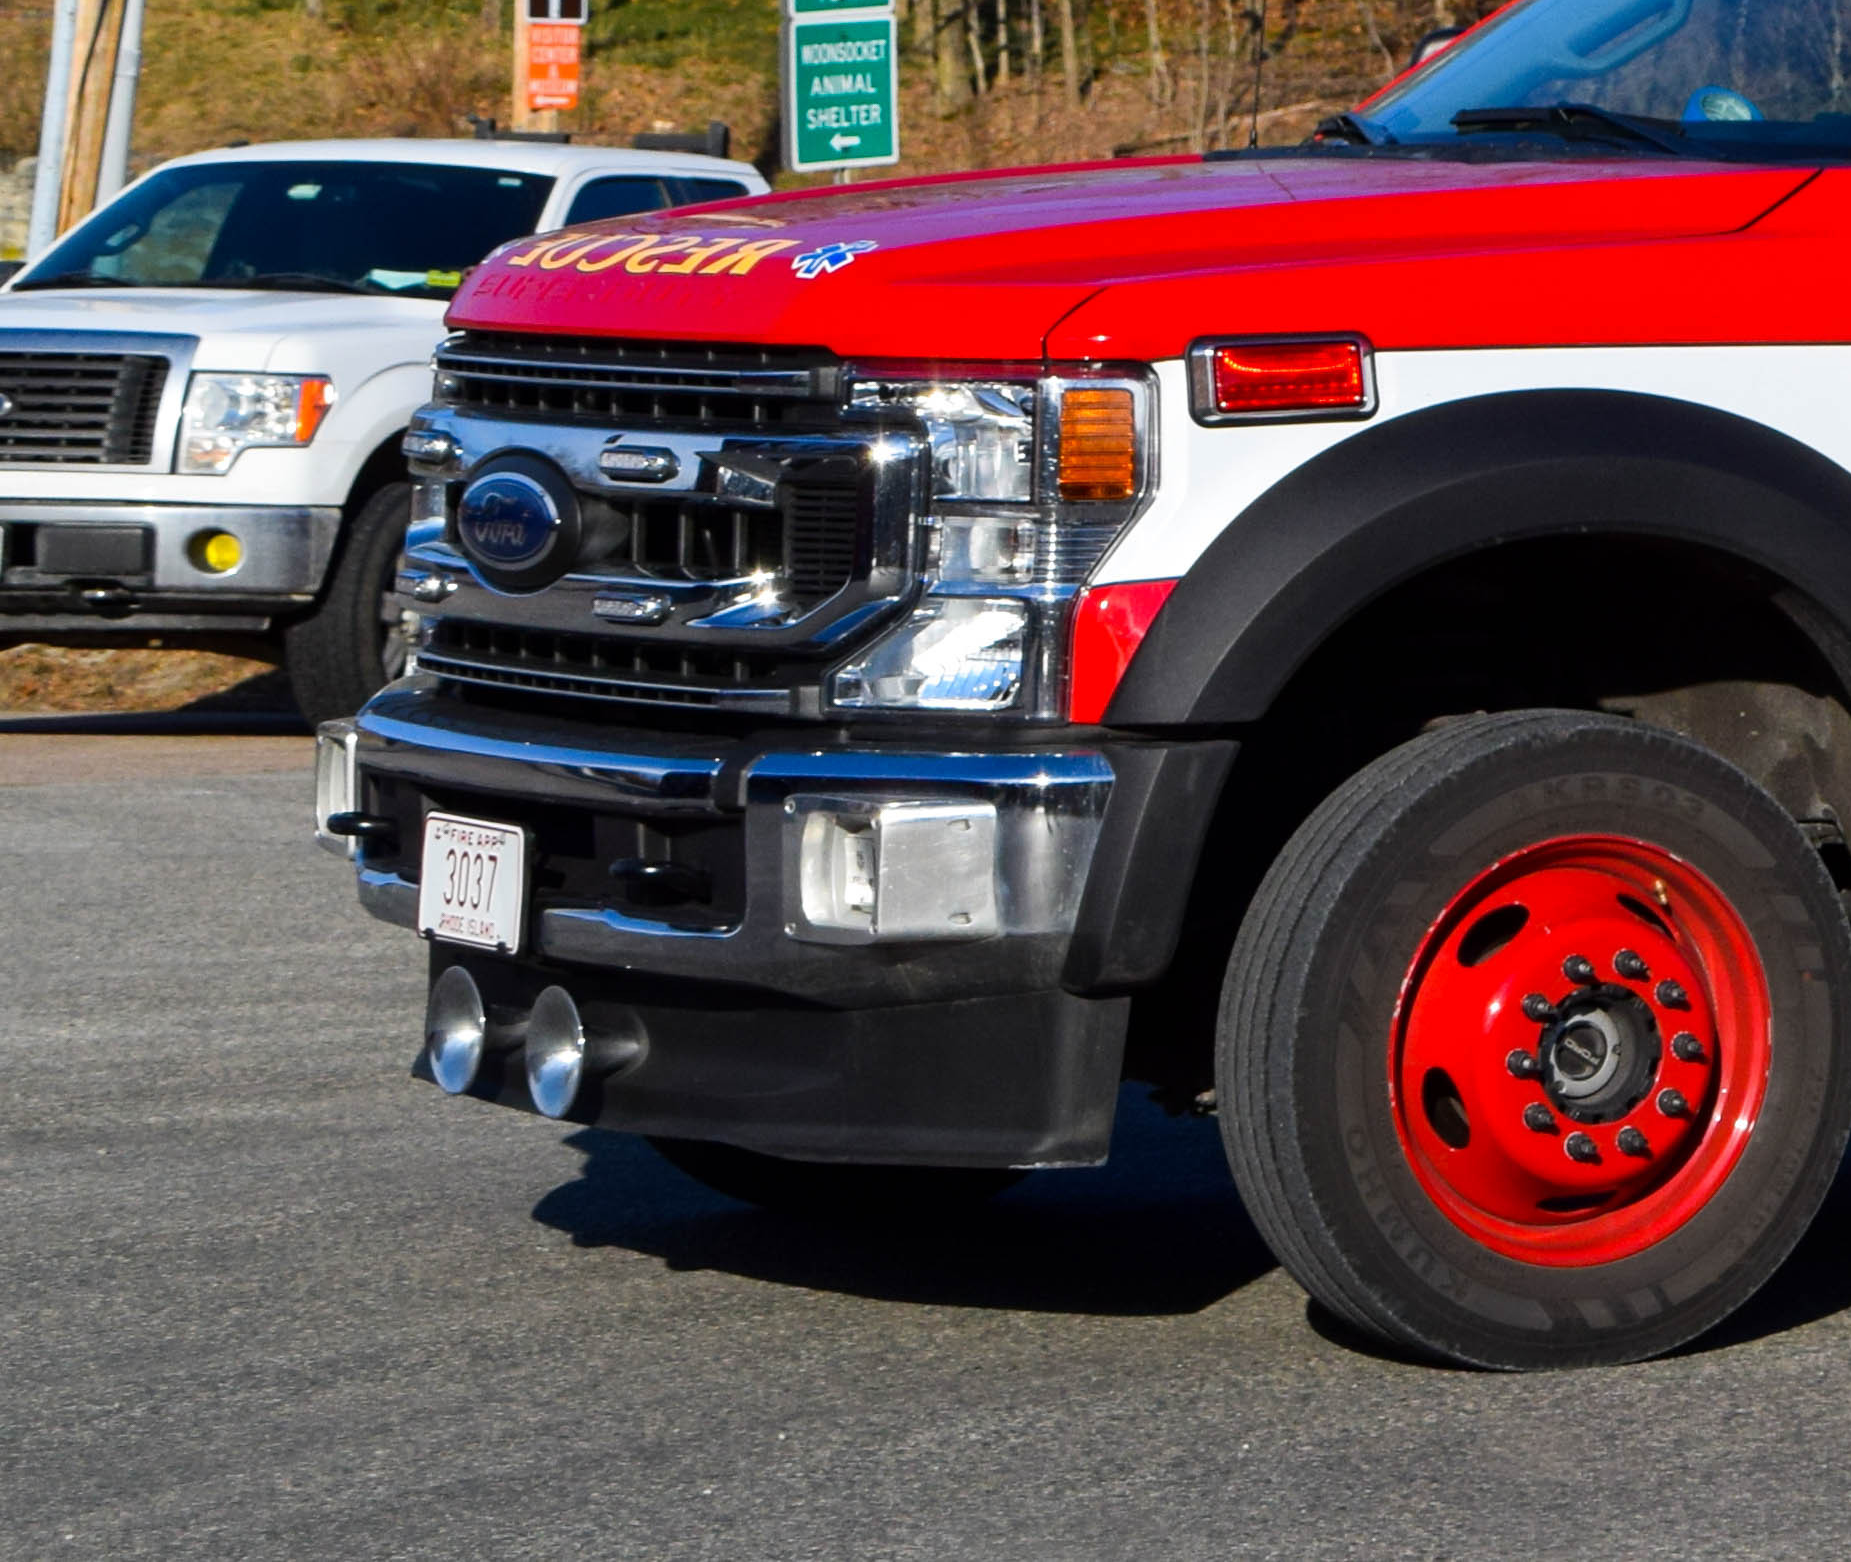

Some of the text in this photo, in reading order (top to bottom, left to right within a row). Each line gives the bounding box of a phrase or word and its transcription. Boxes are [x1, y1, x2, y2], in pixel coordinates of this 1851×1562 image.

[801, 39, 887, 65] WOONSOCKET
[810, 73, 877, 95] ANIMAL
[806, 104, 881, 129] SHELTER
[443, 849, 498, 913] 3037
